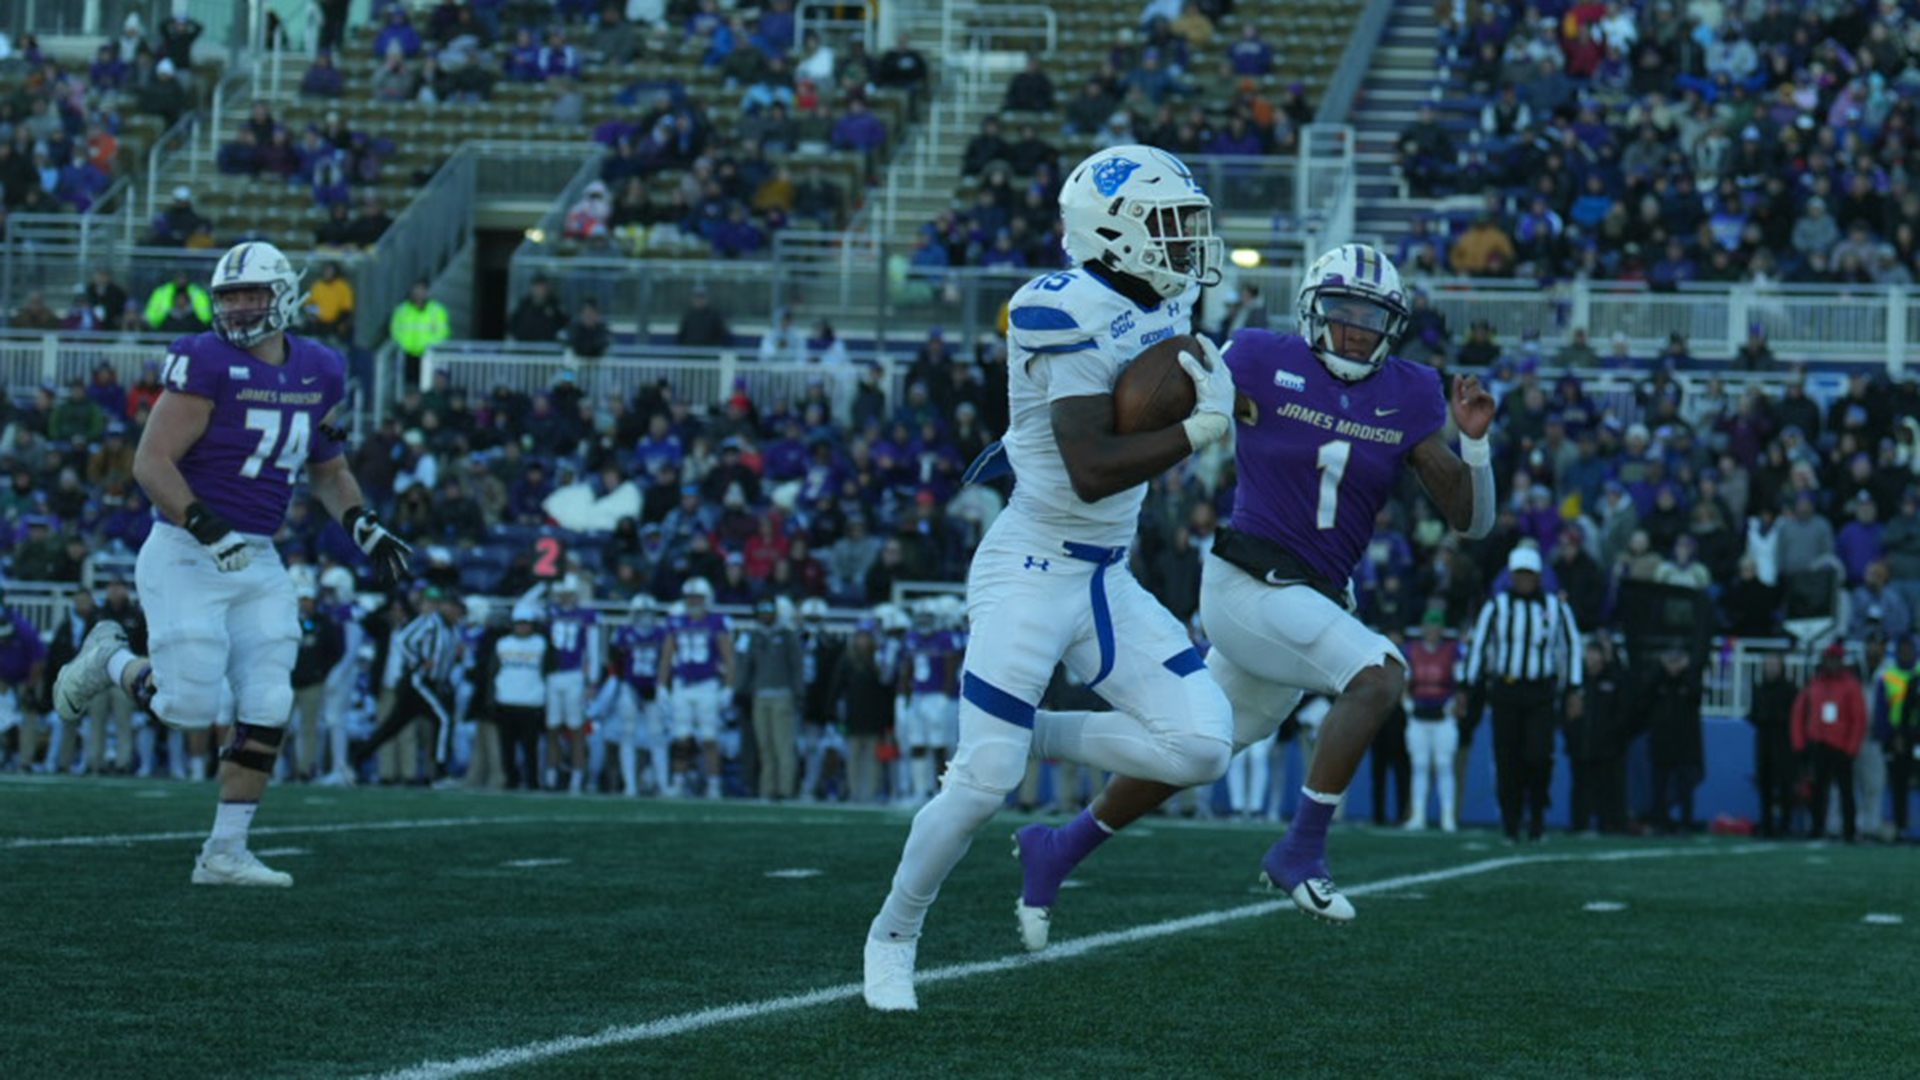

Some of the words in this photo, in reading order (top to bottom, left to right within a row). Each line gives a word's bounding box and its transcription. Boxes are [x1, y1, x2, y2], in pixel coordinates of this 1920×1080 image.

[1034, 272, 1078, 291] 15
[161, 353, 190, 391] 74
[236, 387, 278, 404] JAMES
[279, 391, 323, 406] MADISON
[1276, 402, 1334, 430] JAMES
[1334, 419, 1404, 446] MADISON
[238, 407, 312, 485] 74
[1316, 439, 1351, 531] 1
[533, 537, 560, 577] 2
